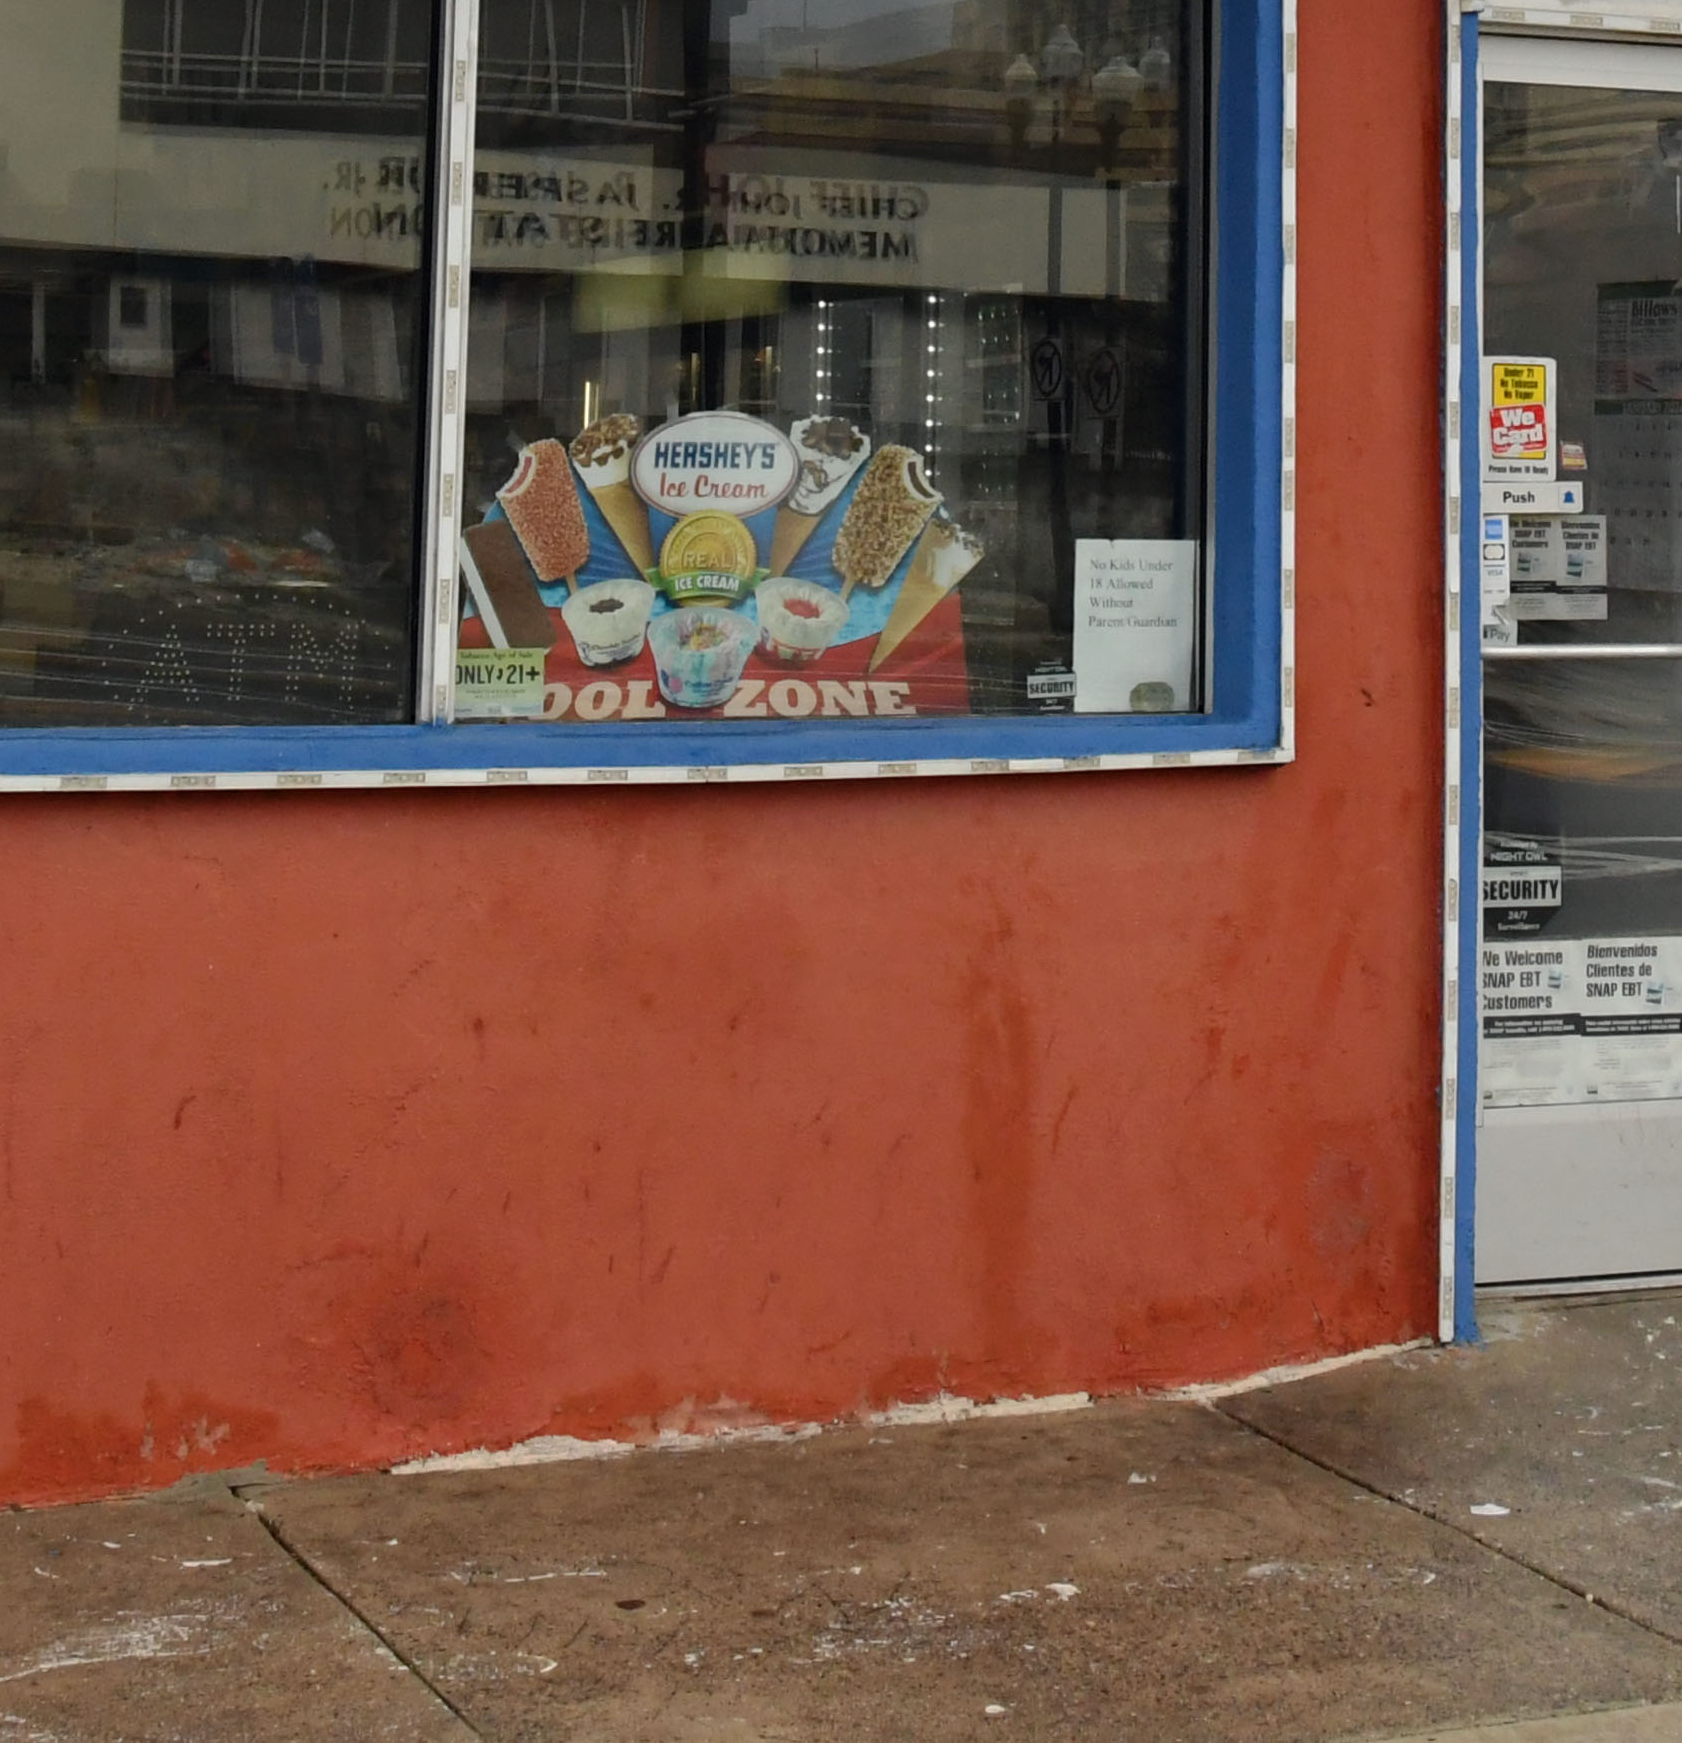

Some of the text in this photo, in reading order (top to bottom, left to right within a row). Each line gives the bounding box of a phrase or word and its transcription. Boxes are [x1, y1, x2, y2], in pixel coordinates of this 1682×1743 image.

[1500, 408, 1536, 427] We
[1493, 423, 1544, 446] Card
[654, 441, 776, 469] HERSHEY'S
[659, 471, 767, 499] Ice Cream
[1503, 491, 1536, 504] Push
[683, 552, 737, 569] REAL
[1090, 559, 1174, 572] No Kids Under
[675, 575, 739, 592] ICE CREAM
[1090, 578, 1154, 590] 18 Allowed
[1089, 596, 1134, 608] Without
[1490, 628, 1511, 643] Pay
[506, 664, 540, 686] 21+
[1029, 681, 1074, 694] SECURITY
[543, 679, 667, 721] OOL
[723, 678, 917, 718] ZONE
[1483, 879, 1559, 902] SECURITY
[1507, 911, 1528, 921] 24/7
[1504, 950, 1564, 966] Welcome
[1587, 943, 1659, 959] Bienvenidos
[1586, 962, 1653, 978] Clientes de
[1519, 971, 1542, 988] EBT
[1586, 981, 1644, 998] SNAP EBT
